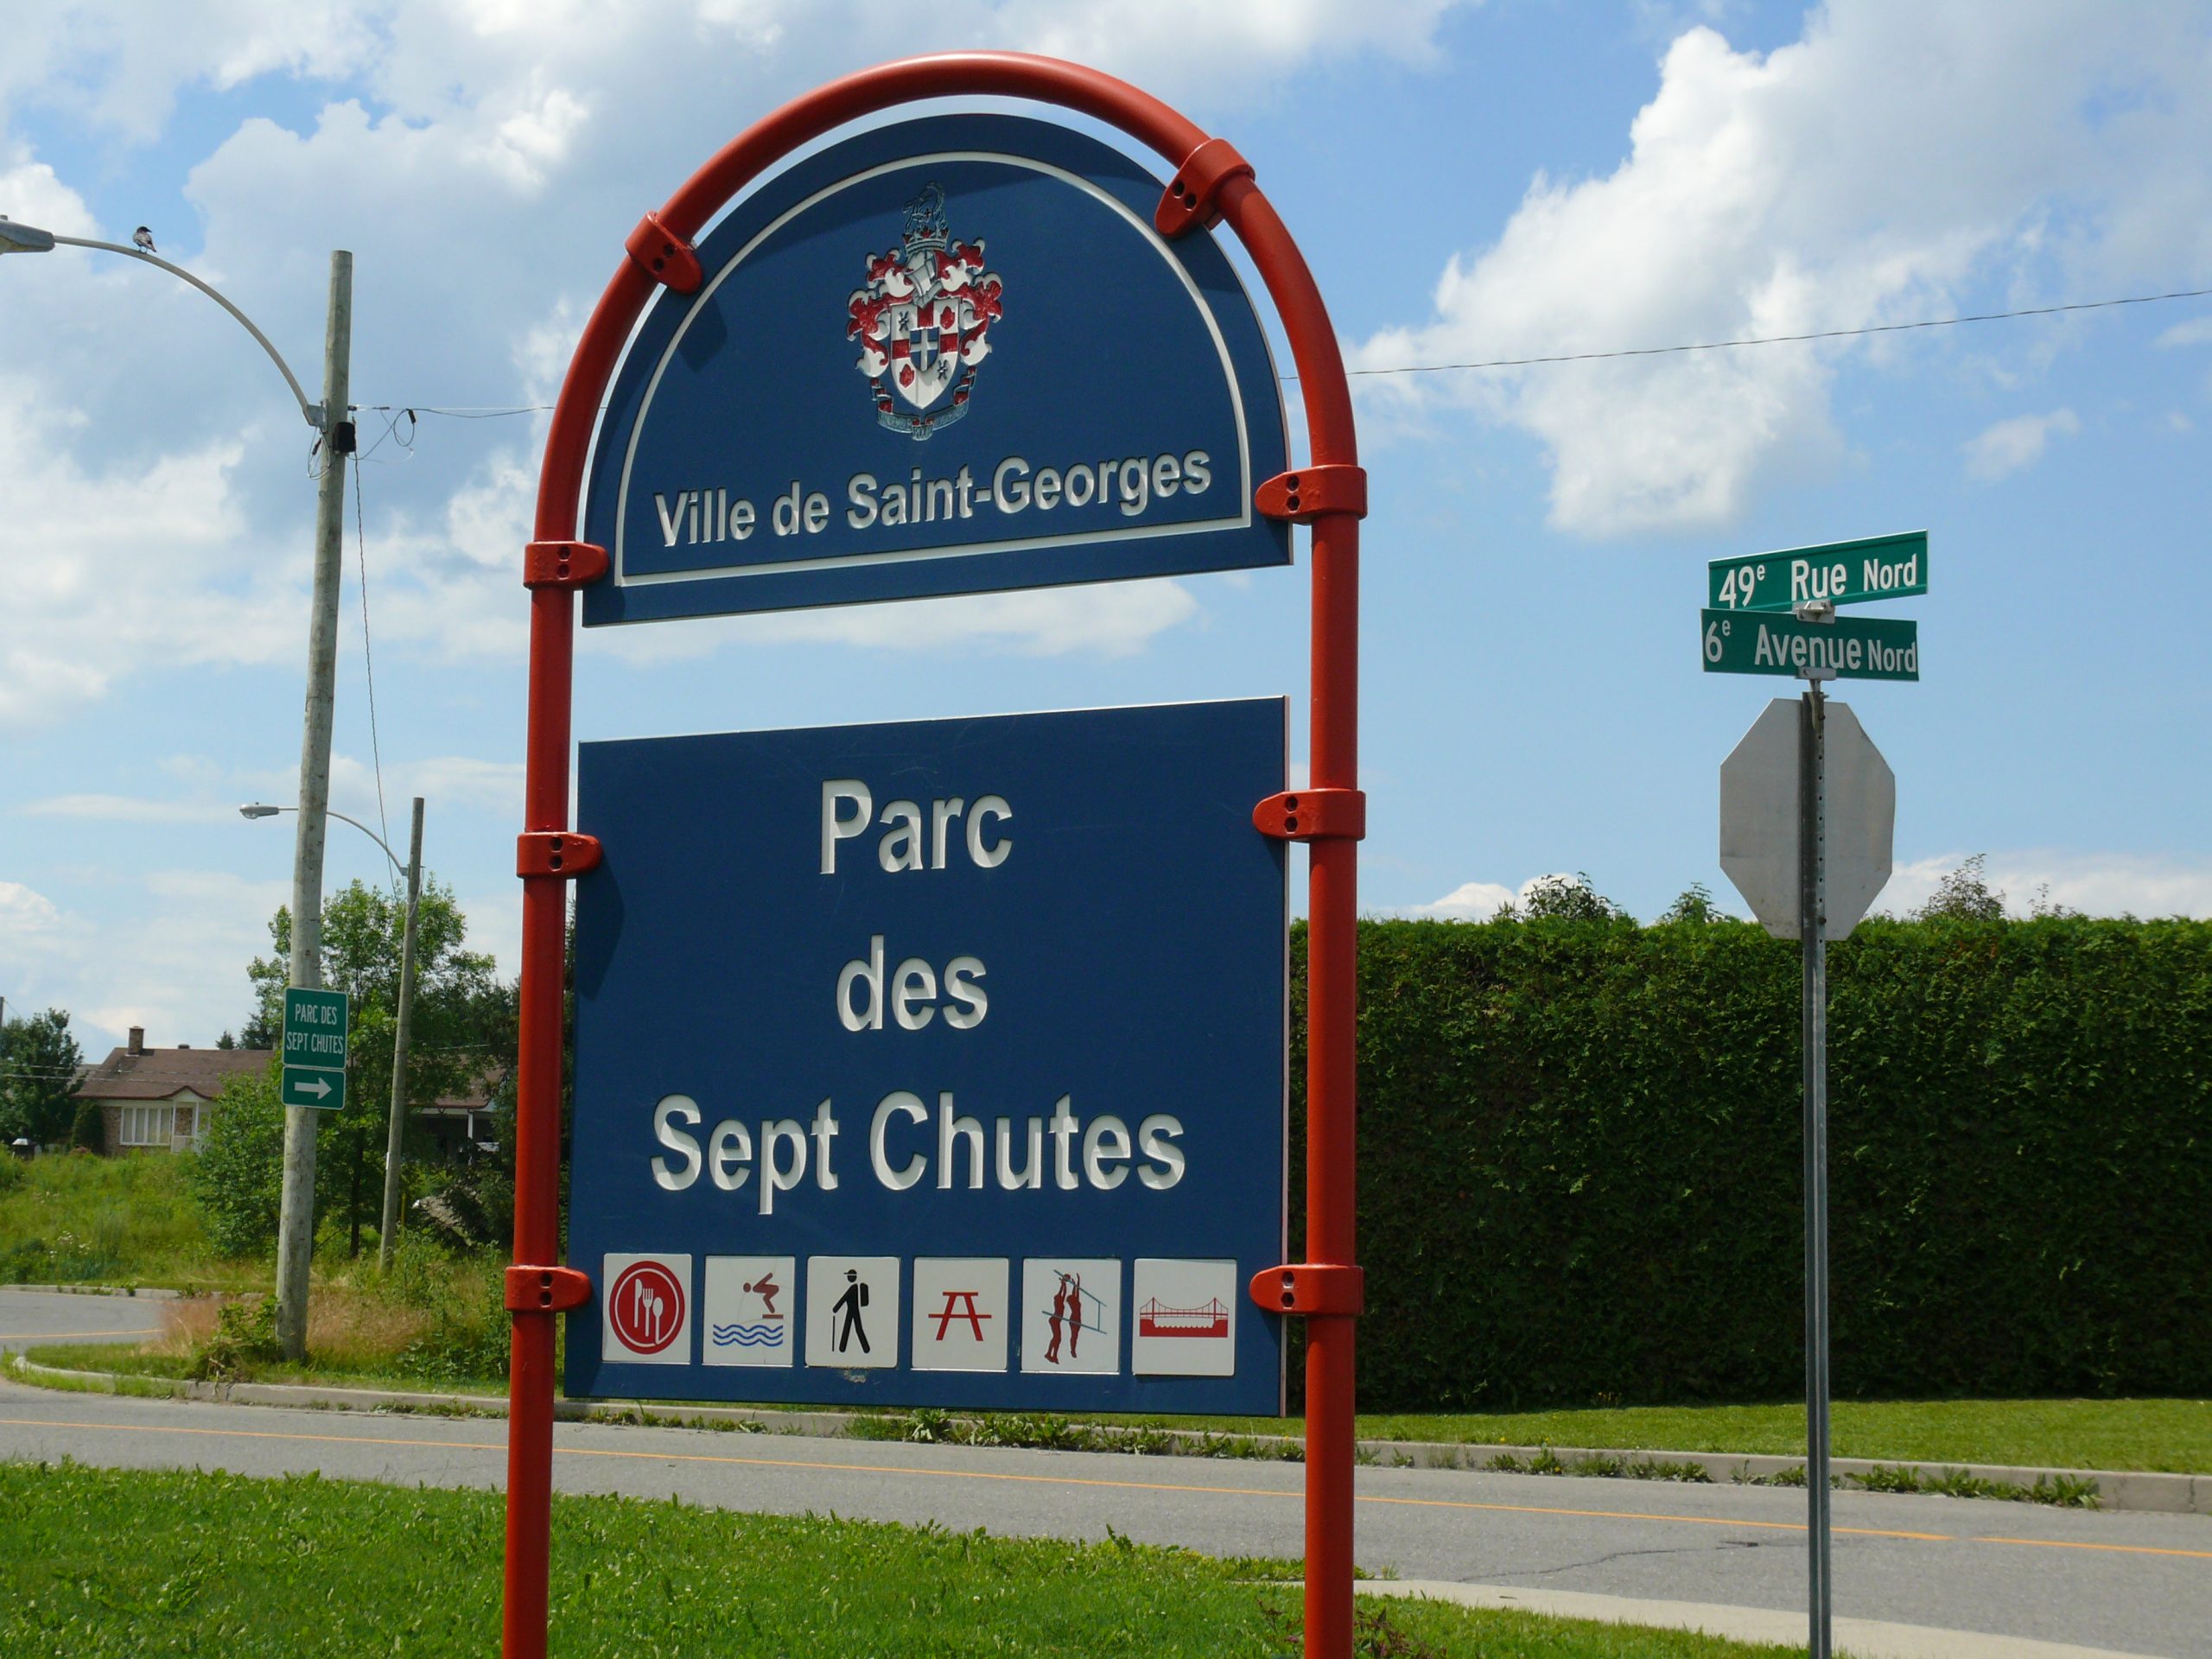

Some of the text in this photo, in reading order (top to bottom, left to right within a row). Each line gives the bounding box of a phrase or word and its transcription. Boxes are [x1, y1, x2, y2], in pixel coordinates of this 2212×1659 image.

[654, 448, 1211, 547] Ville de Saint-Georges
[1791, 559, 1847, 601] Rue
[1863, 552, 1917, 592] Nord
[1754, 624, 1862, 670] Avenue
[1867, 639, 1916, 673] Nord
[820, 777, 1014, 874] Parc
[295, 1003, 338, 1025] PARC DES
[836, 933, 989, 1033] des
[286, 1032, 344, 1054] SEPT CHUTES
[650, 1090, 1186, 1216] Sept Chutes
